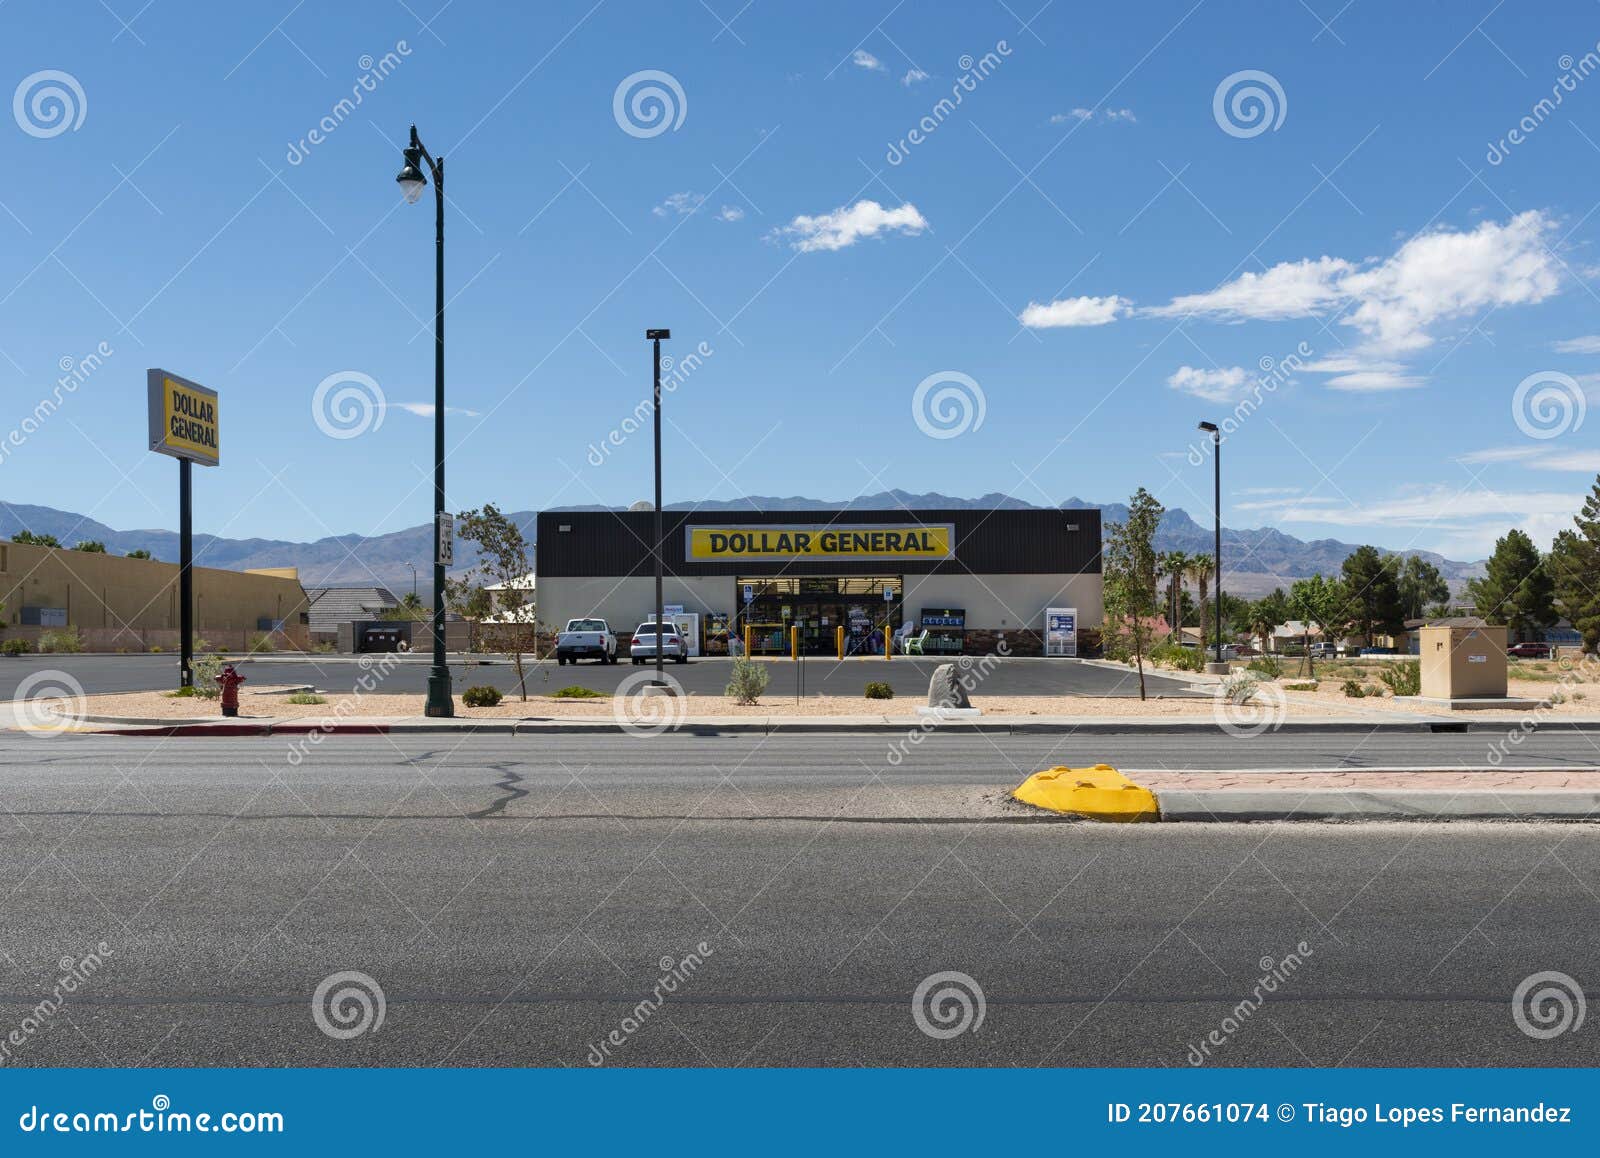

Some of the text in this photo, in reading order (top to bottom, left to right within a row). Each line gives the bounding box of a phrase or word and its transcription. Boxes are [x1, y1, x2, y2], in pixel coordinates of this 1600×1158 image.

[173, 390, 213, 424] DOLLAR
[171, 415, 217, 448] GENERAL
[441, 540, 451, 560] 35
[709, 532, 935, 553] DOLLAR GENERAL
